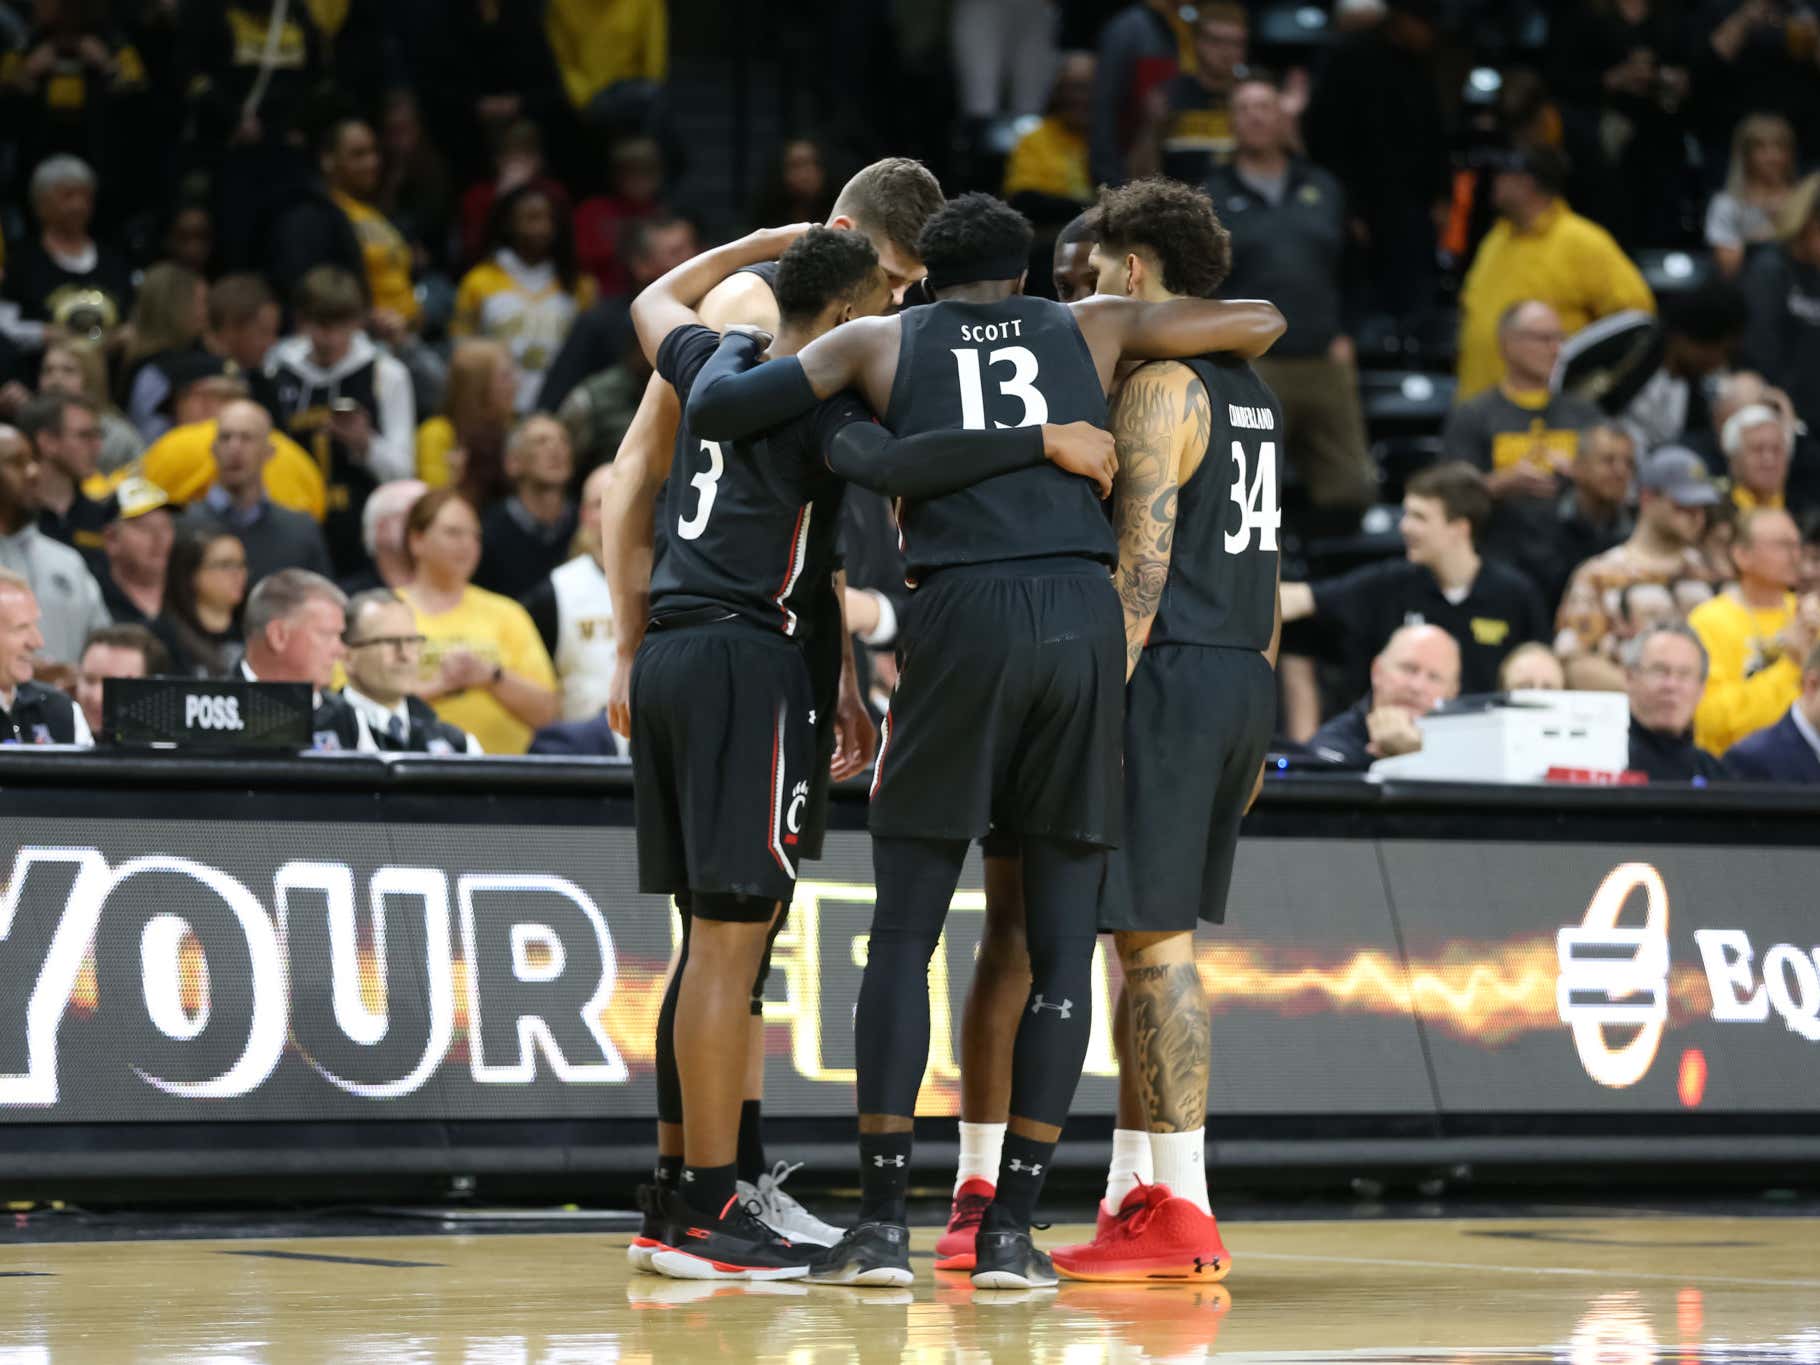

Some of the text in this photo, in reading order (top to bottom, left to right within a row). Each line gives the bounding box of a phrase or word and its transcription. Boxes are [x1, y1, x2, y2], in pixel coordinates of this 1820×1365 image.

[961, 319, 1022, 342] SCOTT
[950, 345, 1049, 430] 13
[678, 439, 724, 540] 3
[1224, 441, 1282, 555] 34
[185, 694, 244, 731] POSS.
[0, 844, 628, 1106] YOUR
[1693, 929, 1820, 1041] EQ
